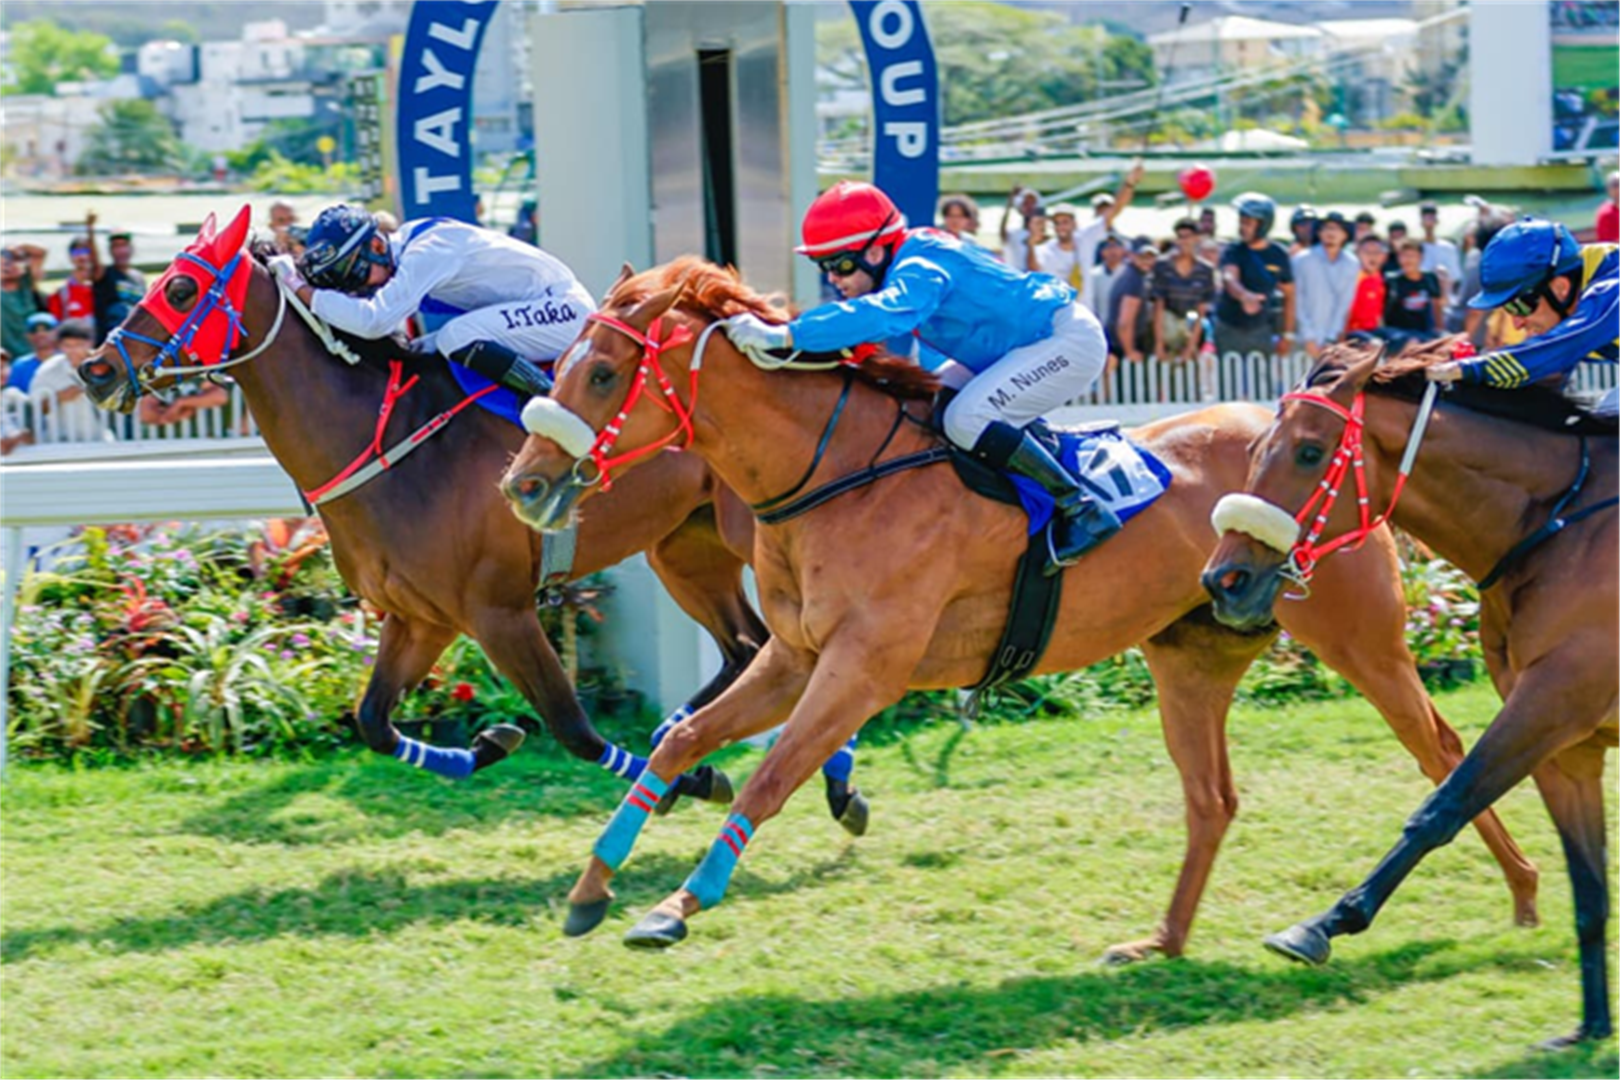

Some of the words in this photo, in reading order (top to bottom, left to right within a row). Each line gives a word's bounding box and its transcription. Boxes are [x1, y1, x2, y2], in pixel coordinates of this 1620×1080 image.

[413, 0, 484, 205] TAYL
[988, 388, 1016, 411] M.
[1010, 355, 1069, 391] Nunes
